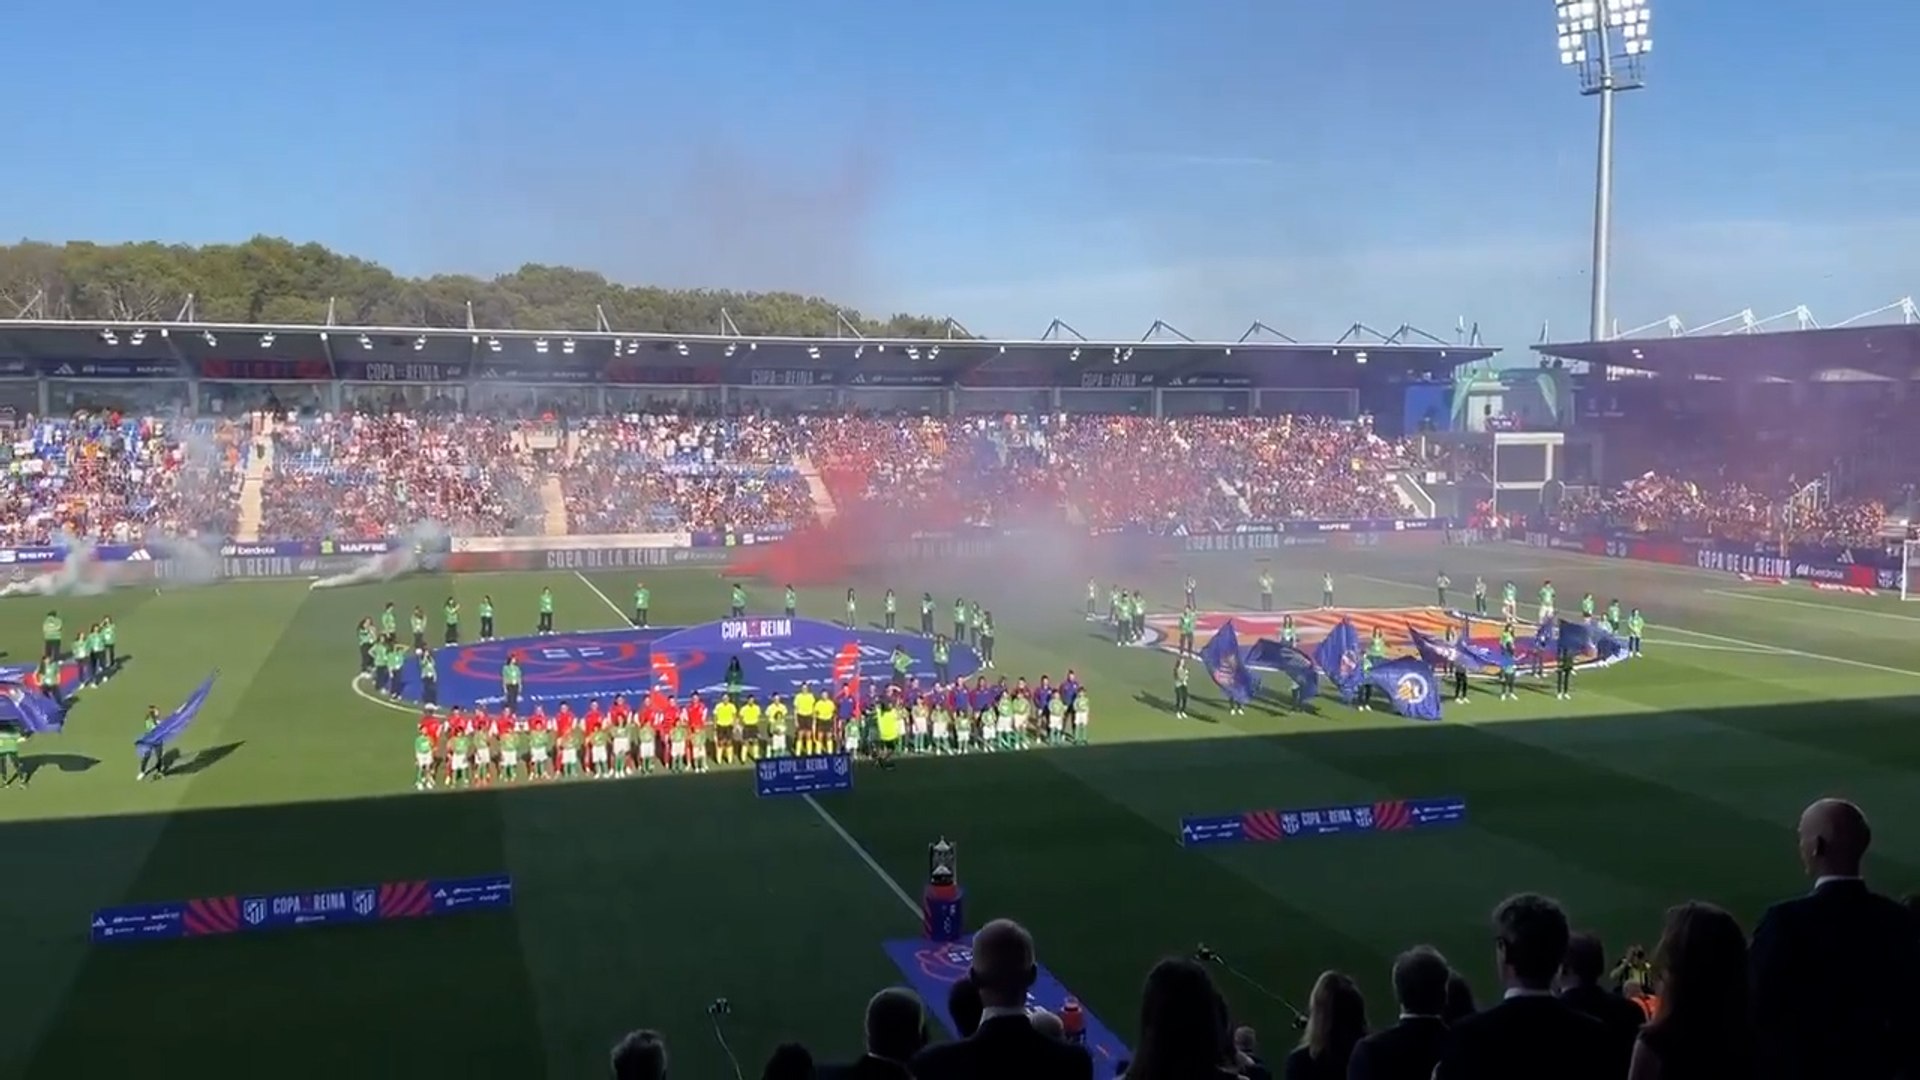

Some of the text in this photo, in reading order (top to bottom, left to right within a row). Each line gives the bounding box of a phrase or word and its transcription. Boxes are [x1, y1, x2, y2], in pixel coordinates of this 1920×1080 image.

[366, 363, 395, 381] COPA
[406, 363, 440, 380] REINA
[1319, 522, 1351, 531] MAPFRE
[237, 545, 276, 555] Iberdrola
[338, 543, 387, 553] MAPFRE
[1185, 533, 1279, 551] COPA DE LA REINA
[547, 548, 668, 568] COPA DE LA REINA
[1697, 549, 1791, 577] COPA DE LA REINA
[223, 558, 240, 578] LA
[246, 557, 292, 577] REINA
[1810, 567, 1844, 579] Iberdrola
[721, 621, 749, 639] COPA
[760, 620, 792, 637] REINA
[778, 759, 798, 774] COPA
[805, 757, 829, 772] REINA
[1301, 809, 1352, 826] COPA REINA
[272, 892, 346, 914] COPA REINA
